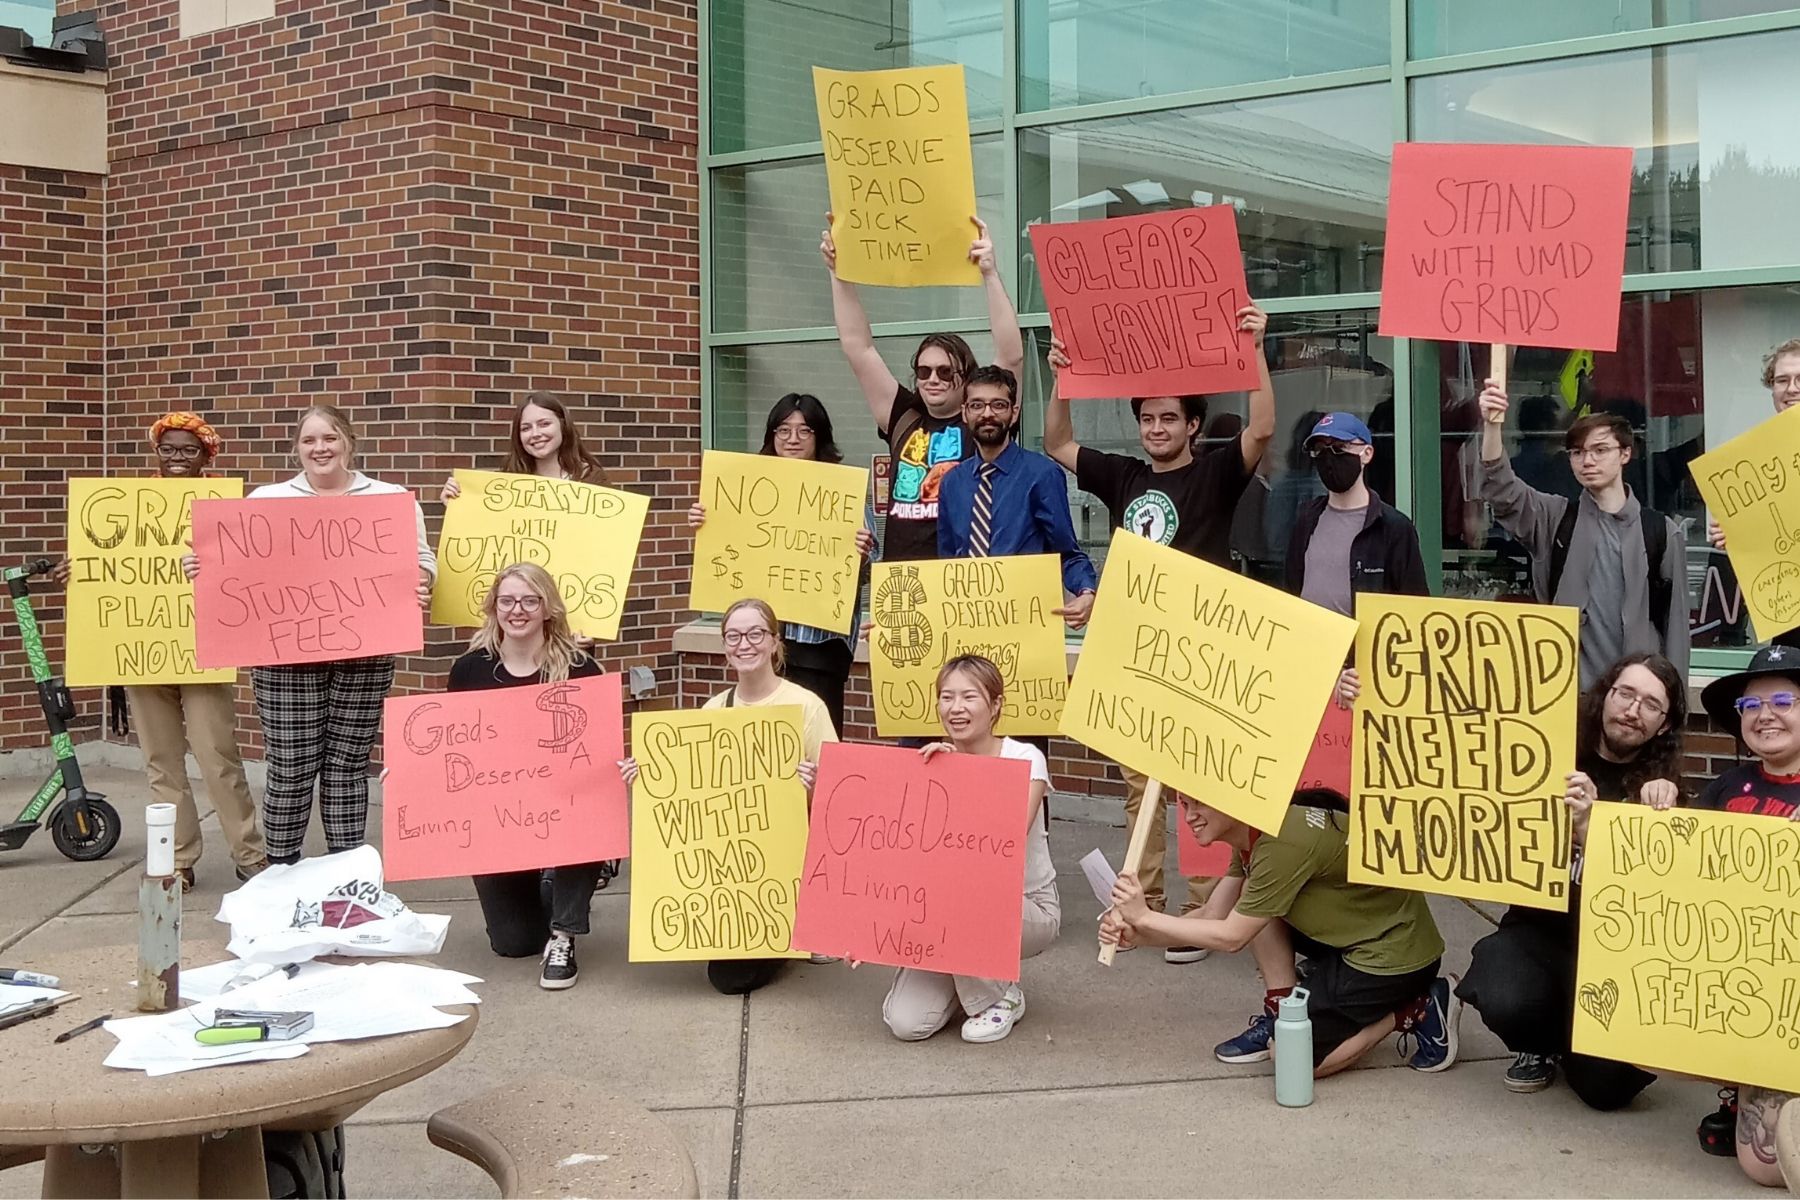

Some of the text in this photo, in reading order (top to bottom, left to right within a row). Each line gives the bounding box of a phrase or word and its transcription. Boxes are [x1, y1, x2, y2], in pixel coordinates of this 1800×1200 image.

[828, 80, 940, 120] GRADS
[827, 130, 945, 167] DESERVE
[849, 175, 925, 205] PAID
[1424, 177, 1575, 237] STAND
[851, 209, 917, 234] SICK
[1046, 214, 1218, 295] CLEAR
[1411, 241, 1593, 279] WITH UMD
[1440, 278, 1560, 335] GRADS
[1054, 288, 1246, 377] LEAVE!
[81, 487, 223, 549] GRA
[484, 478, 625, 518] STAND
[715, 475, 779, 517] NO
[797, 481, 858, 524] MORE
[217, 514, 397, 565] NO MORE
[445, 536, 551, 573] UMD
[511, 519, 557, 540] WITH
[747, 521, 842, 558] STUDENT
[76, 556, 190, 585] INSURAN
[767, 565, 823, 593] FEES
[942, 561, 1004, 598] GRADS
[98, 593, 195, 628] PLAN
[218, 574, 392, 627] STUDENT
[466, 573, 617, 619] GDS
[942, 596, 1046, 630] DESERVE A
[1127, 559, 1290, 651] WE WANT
[115, 640, 205, 676] NOW
[268, 615, 361, 659] FEES
[1133, 624, 1276, 714] PASSING
[1372, 611, 1576, 716] GRAD
[404, 701, 498, 756] Grads
[1087, 689, 1277, 800] INSURANCE
[1363, 710, 1551, 796] NEED
[445, 742, 591, 792] Deserve A
[638, 720, 801, 799] STAND
[398, 804, 472, 848] Living
[653, 784, 770, 848] WITH
[825, 773, 1017, 859] Grads Deserve
[675, 839, 766, 890] UMD
[1359, 793, 1572, 897] MORE!
[1610, 816, 1800, 898] NO MOR
[808, 853, 927, 924] A Living
[874, 921, 946, 964] Wage!
[1590, 884, 1800, 966] STUDEN
